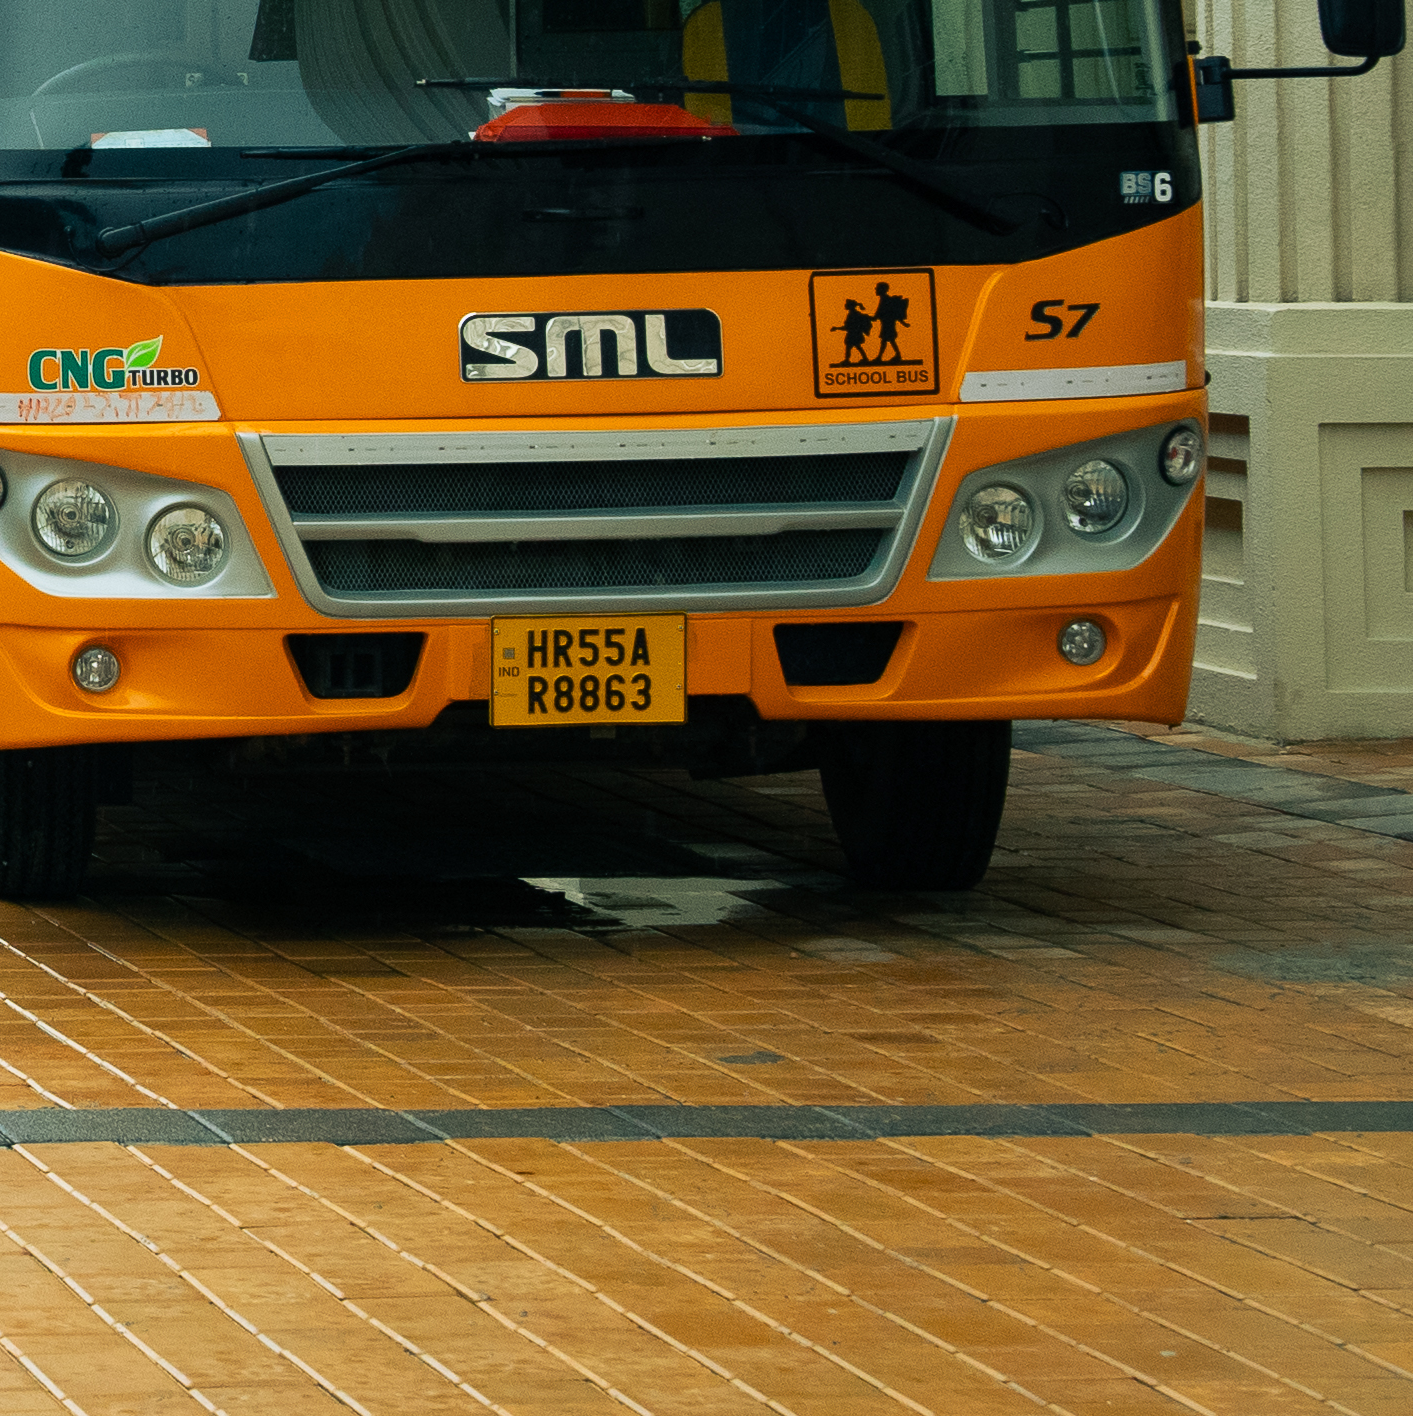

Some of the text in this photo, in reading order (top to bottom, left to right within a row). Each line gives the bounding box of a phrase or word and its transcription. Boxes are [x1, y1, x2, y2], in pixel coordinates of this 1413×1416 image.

[1024, 299, 1101, 341] S7
[462, 313, 719, 378] SML
[28, 349, 126, 390] CNG
[128, 368, 199, 387] TURBO
[823, 369, 929, 386] SCHOOL BUS
[527, 627, 651, 669] HR55A
[498, 666, 520, 677] IND
[528, 673, 652, 715] R8863
